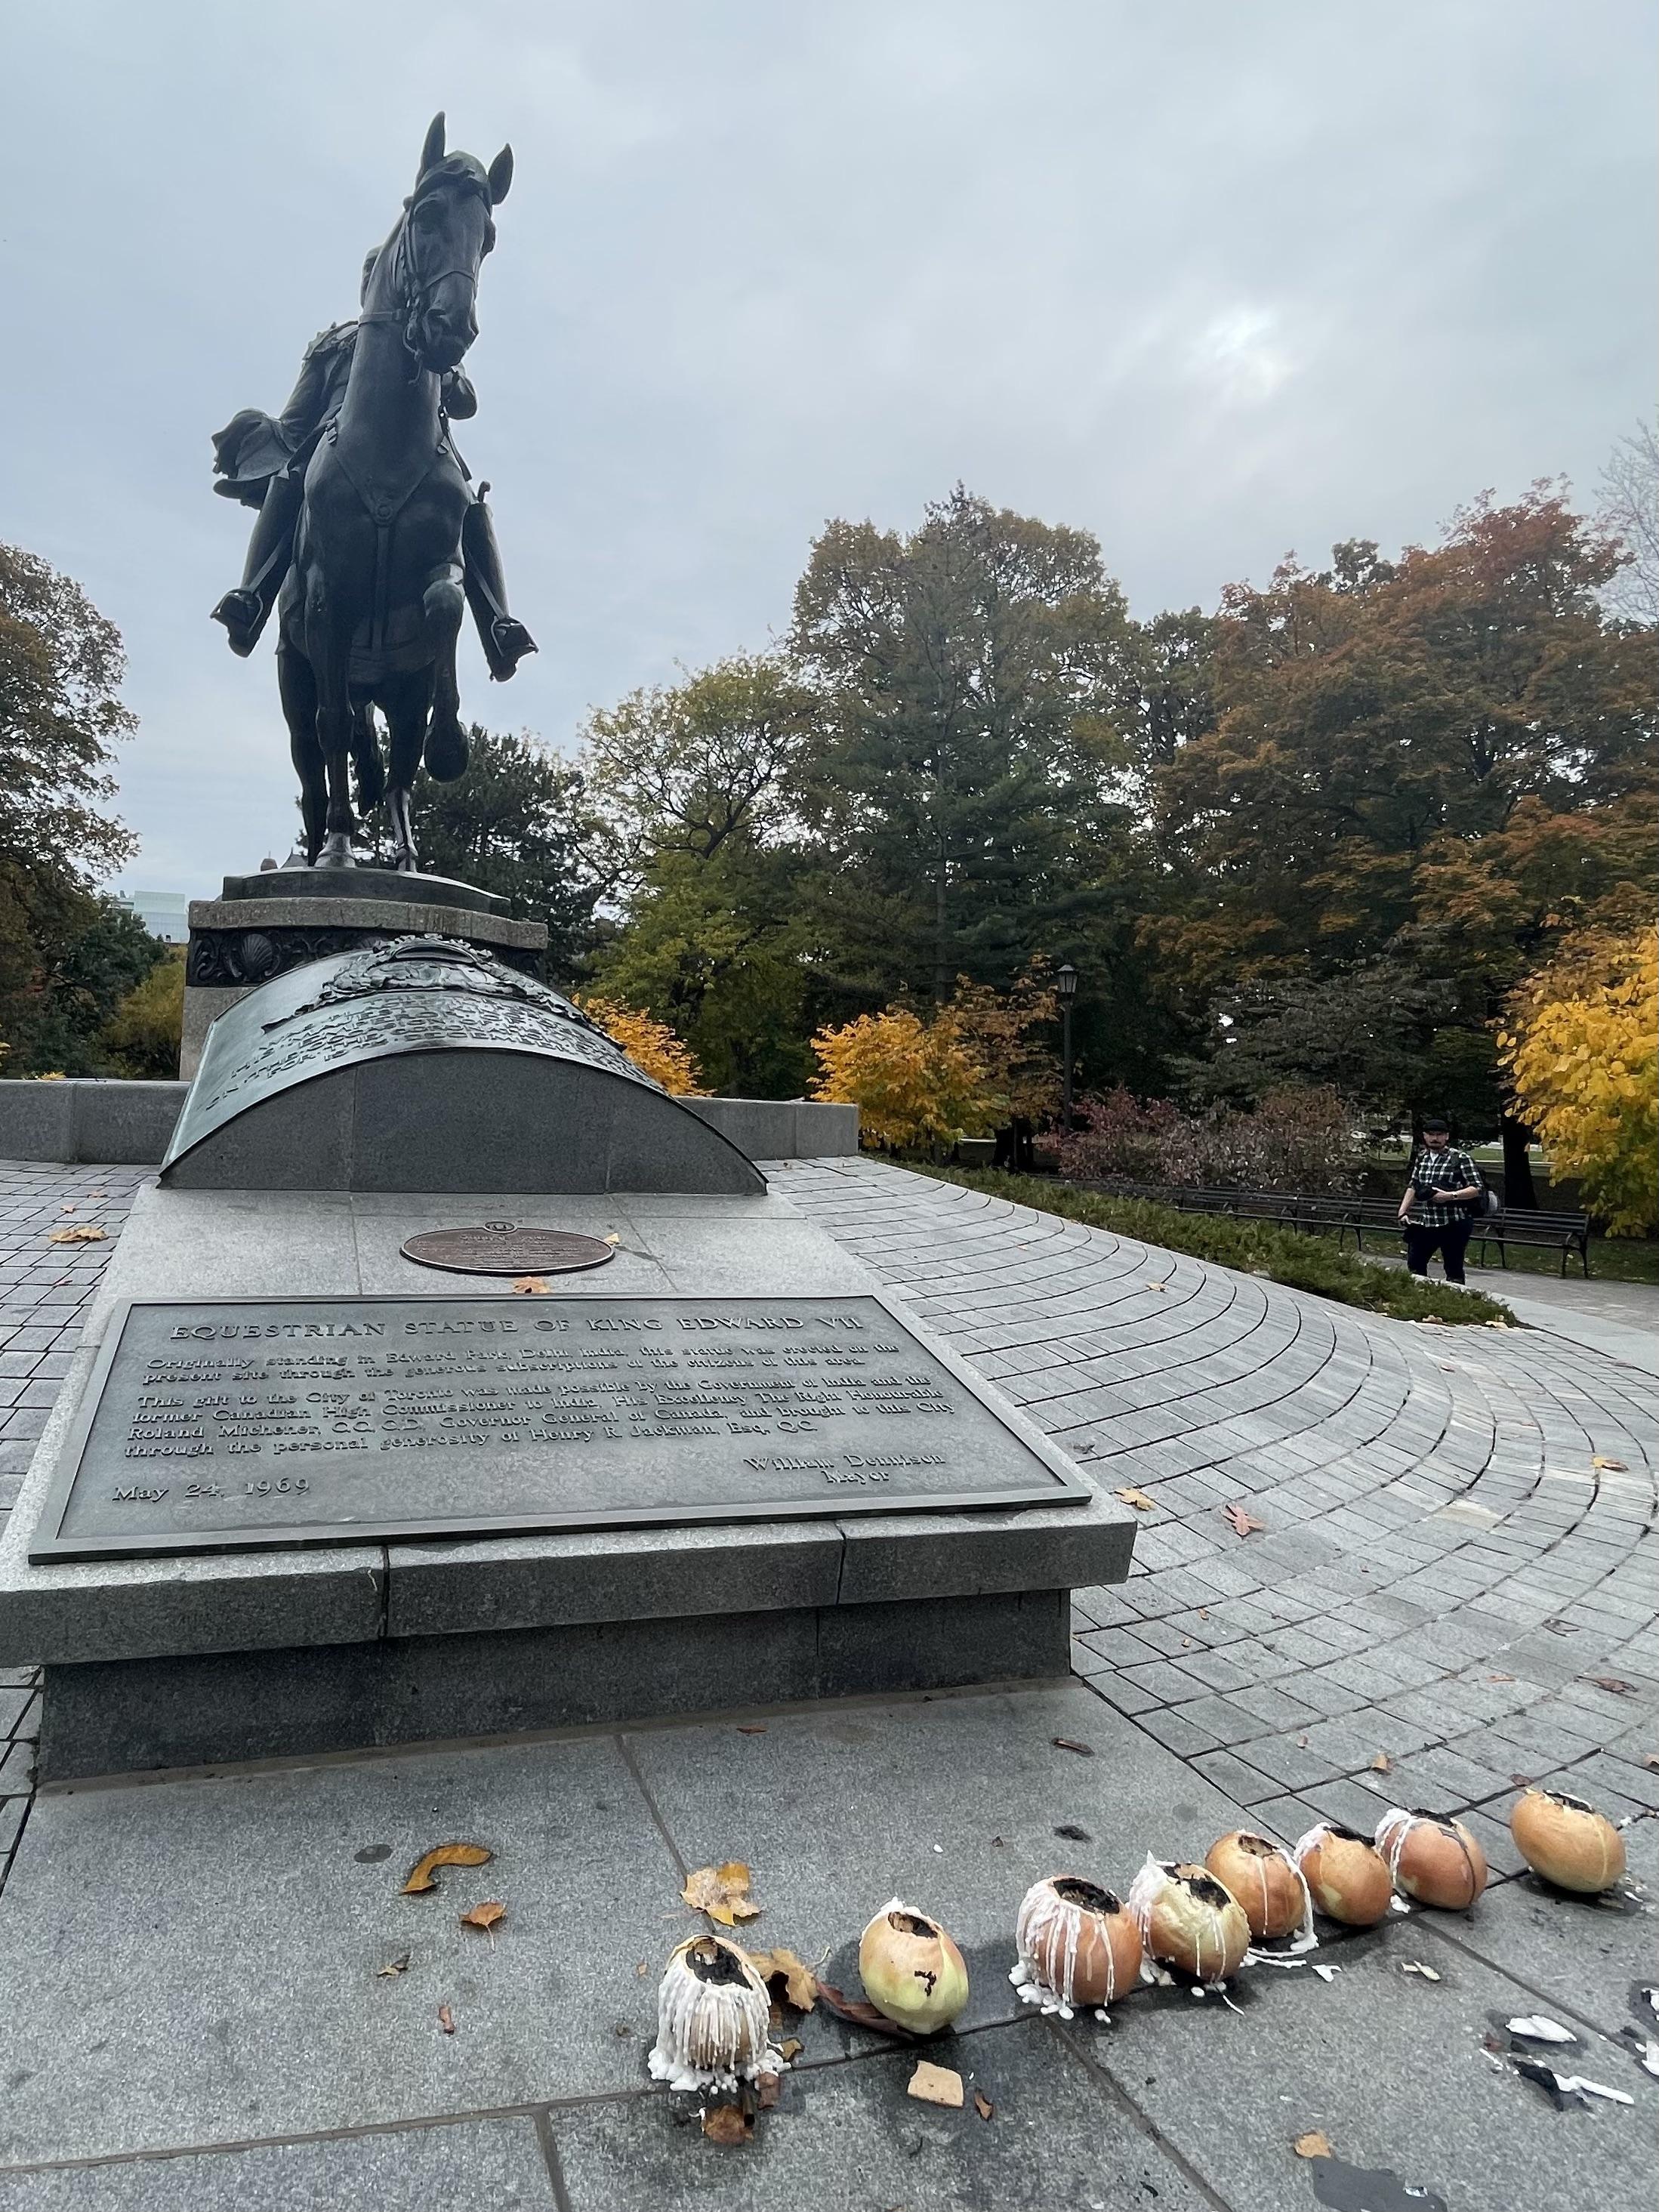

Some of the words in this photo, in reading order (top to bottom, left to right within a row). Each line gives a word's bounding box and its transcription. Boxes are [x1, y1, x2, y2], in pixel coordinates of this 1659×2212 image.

[403, 1032, 572, 1054] DECEMBER
[267, 1054, 316, 1078] FOR
[170, 1323, 386, 1340] EQUESTRIAN
[405, 1320, 520, 1334] STATUE
[533, 1319, 571, 1331] OF
[586, 1319, 664, 1331] KING
[677, 1317, 805, 1330] EDWARD
[815, 1317, 865, 1329] VII
[147, 1359, 255, 1369] Originally
[266, 1356, 348, 1366] standing
[357, 1355, 376, 1364] in
[385, 1353, 457, 1363] Edward
[639, 1347, 674, 1356] this
[681, 1347, 733, 1356] statue
[740, 1347, 776, 1355] was
[782, 1344, 843, 1354] erected
[873, 1344, 899, 1353] the
[142, 1373, 221, 1386] present
[232, 1371, 268, 1381] site
[279, 1368, 356, 1380] through
[364, 1367, 394, 1378] the
[405, 1365, 487, 1378] generous
[495, 1362, 618, 1373] subscriptions
[627, 1360, 643, 1368] of
[650, 1359, 679, 1368] the
[686, 1359, 755, 1368] citizens
[761, 1357, 779, 1367] of
[783, 1357, 818, 1366] this
[137, 1396, 184, 1408] This
[193, 1396, 230, 1408] gift
[239, 1396, 259, 1405] to
[267, 1393, 298, 1404] the
[305, 1392, 350, 1405] City
[359, 1392, 376, 1402] of
[384, 1389, 455, 1401] Toronto
[460, 1387, 499, 1397] was
[506, 1384, 553, 1396] made
[557, 1381, 631, 1396] possible
[634, 1381, 658, 1394] by
[664, 1380, 691, 1390] the
[697, 1379, 796, 1391] Government
[801, 1378, 819, 1388] of
[821, 1377, 867, 1387] India
[870, 1376, 903, 1386] and
[905, 1375, 932, 1385] the
[132, 1411, 203, 1424] former
[212, 1409, 312, 1421] Canadian
[322, 1406, 372, 1419] High
[381, 1402, 517, 1415] Commissioner
[524, 1401, 544, 1409] to
[612, 1396, 649, 1407] His
[653, 1393, 748, 1407] Excellency
[754, 1393, 791, 1403] The
[794, 1390, 843, 1404] Right
[845, 1389, 944, 1401] Honourable
[127, 1426, 205, 1442] Roland
[217, 1424, 322, 1439] Michener,
[439, 1416, 532, 1429] Governor
[541, 1410, 620, 1424] General
[628, 1410, 647, 1421] of
[653, 1409, 729, 1421] Canada,
[737, 1408, 773, 1418] and
[776, 1405, 847, 1419] brought
[851, 1405, 871, 1415] to
[874, 1403, 912, 1415] this
[915, 1402, 956, 1415] City
[125, 1443, 215, 1459] through
[227, 1441, 263, 1455] the
[272, 1437, 369, 1455] personal
[379, 1433, 491, 1452] generosity
[500, 1431, 521, 1443] of
[528, 1429, 594, 1443] Henry
[629, 1424, 720, 1439] Jackman,
[743, 1458, 835, 1471] William
[843, 1454, 947, 1467] Dennison
[111, 1483, 171, 1503] May
[243, 1477, 310, 1498] 1969
[820, 1470, 890, 1485] Mayor
